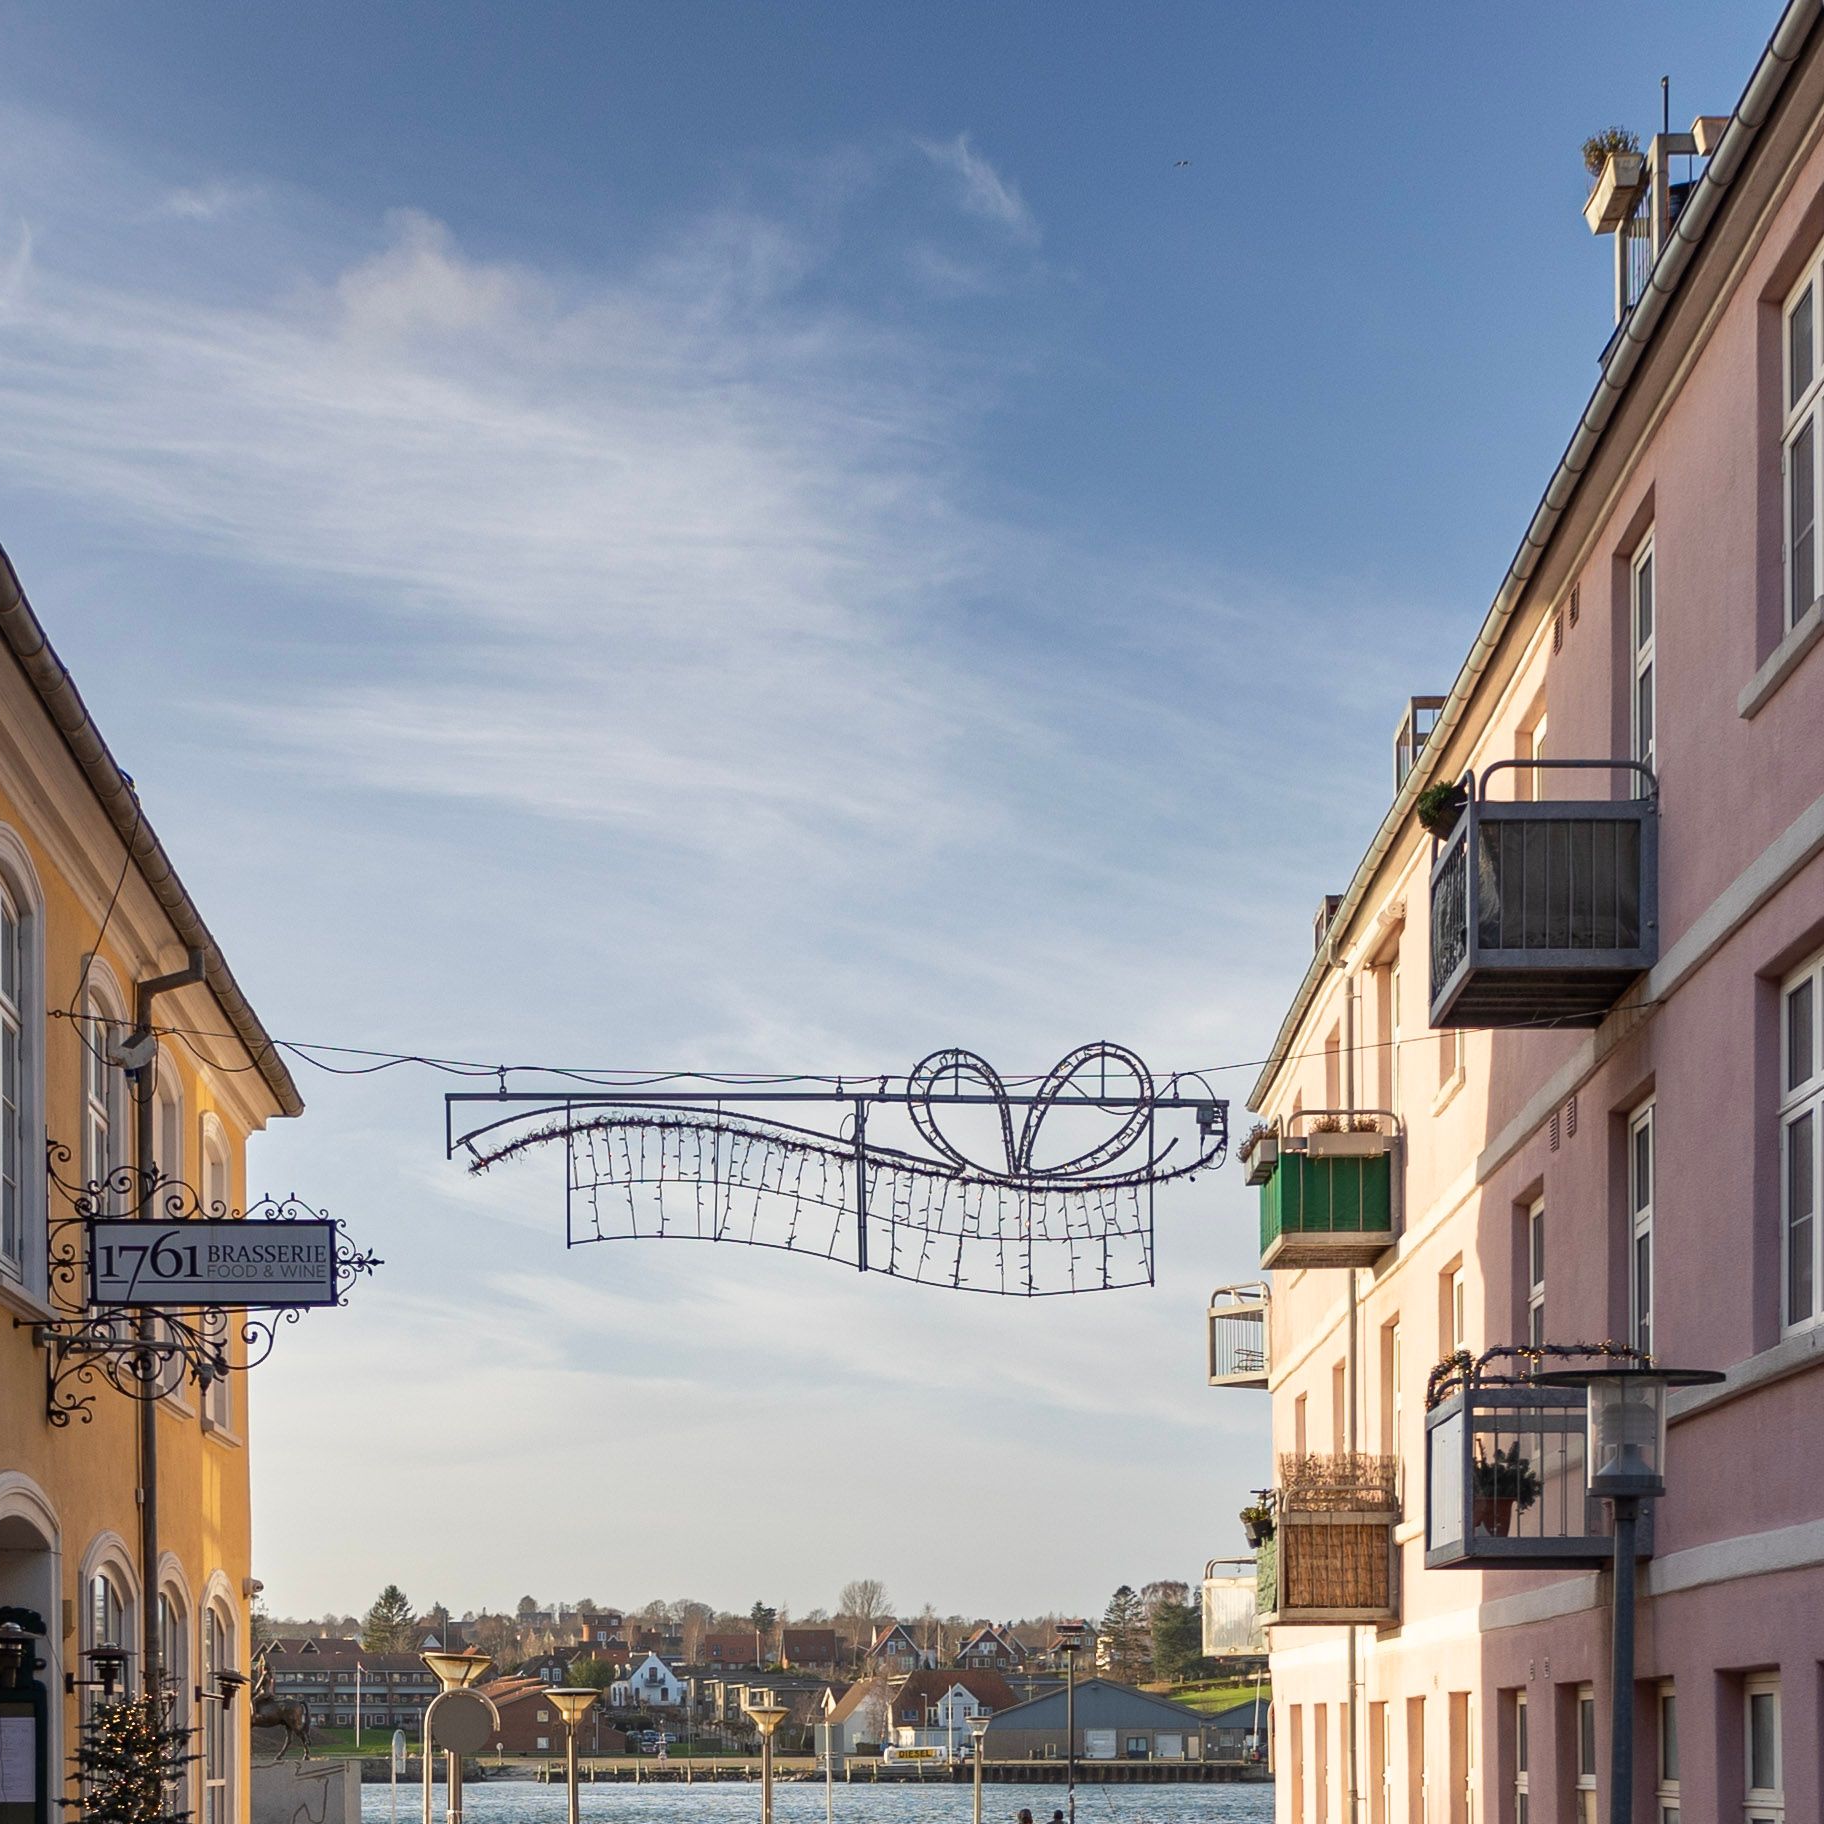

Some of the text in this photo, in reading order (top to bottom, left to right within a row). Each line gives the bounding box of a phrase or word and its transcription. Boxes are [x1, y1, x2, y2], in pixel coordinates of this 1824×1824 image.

[207, 1245, 326, 1263] BRASSERIE
[99, 1230, 203, 1301] 1761
[207, 1265, 326, 1278] FOOD & WINE
[899, 1750, 932, 1758] DIESEL
